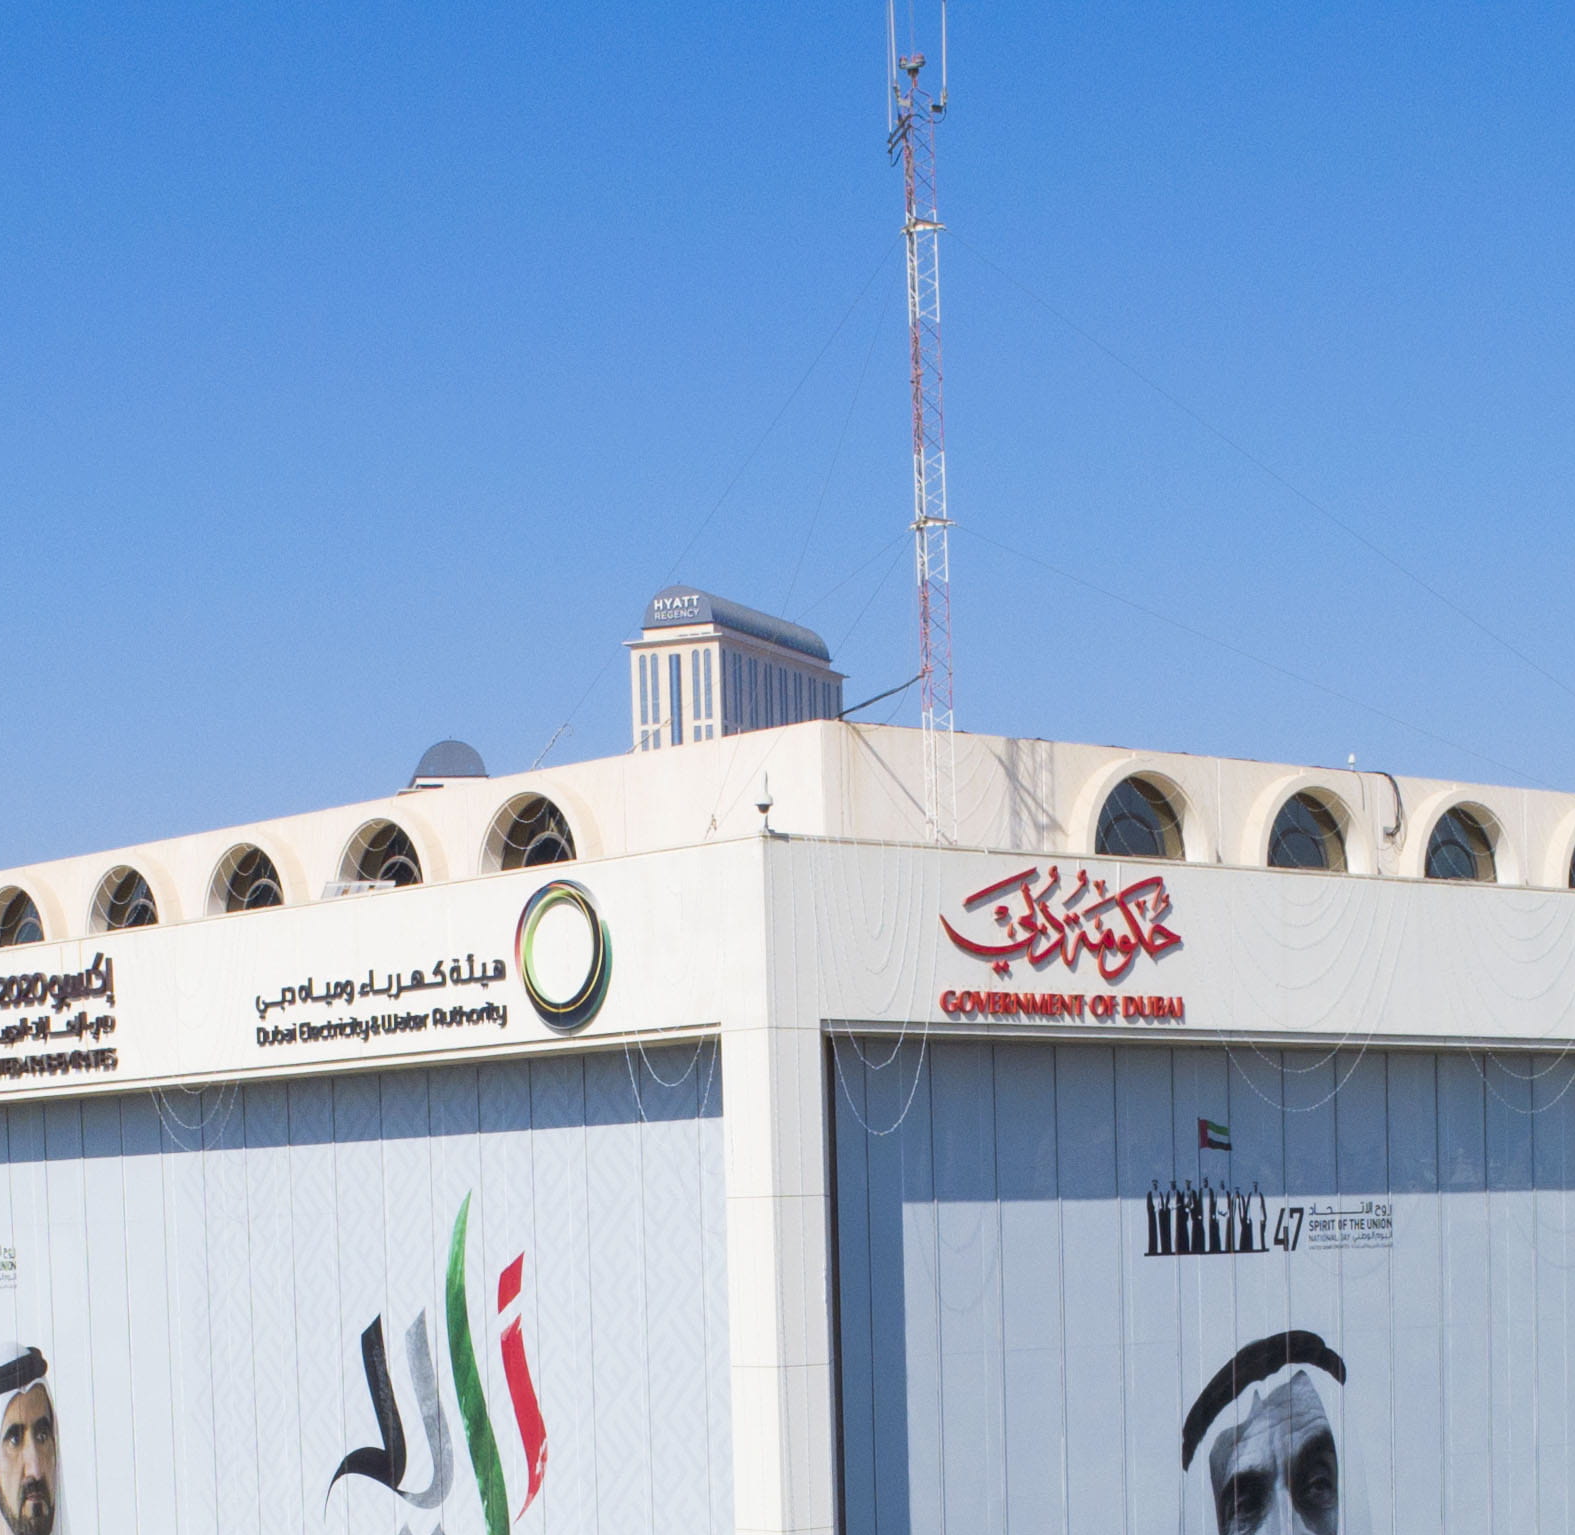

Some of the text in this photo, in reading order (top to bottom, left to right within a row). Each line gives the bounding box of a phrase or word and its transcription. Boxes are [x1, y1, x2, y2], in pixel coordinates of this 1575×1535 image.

[654, 595, 699, 610] HYATT
[654, 608, 699, 620] REGENCY
[256, 954, 507, 1019] هيئة كهرباء ومياه دبي
[939, 990, 1184, 1018] GOVERNMENT OF DUBAI
[256, 1002, 507, 1046] Dubai Electricity & Water Authority
[1274, 1207, 1304, 1251] 47
[1308, 1217, 1393, 1231] SPIRIT OF THE UNION
